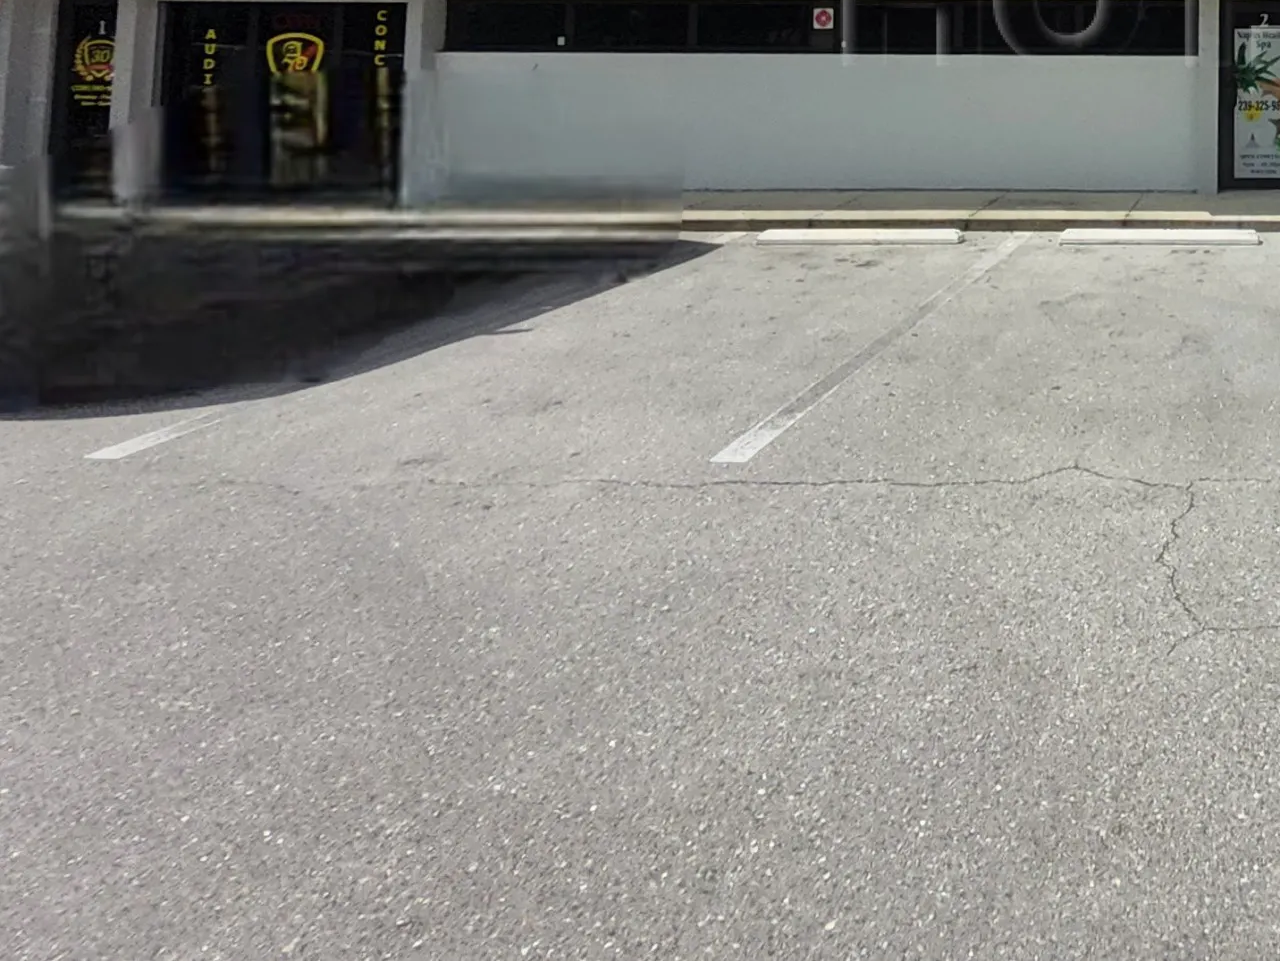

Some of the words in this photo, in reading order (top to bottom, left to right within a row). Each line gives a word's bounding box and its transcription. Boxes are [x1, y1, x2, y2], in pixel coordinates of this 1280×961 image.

[1259, 13, 1270, 27] 2
[1237, 31, 1261, 42] Naps
[1256, 39, 1271, 50] Spa
